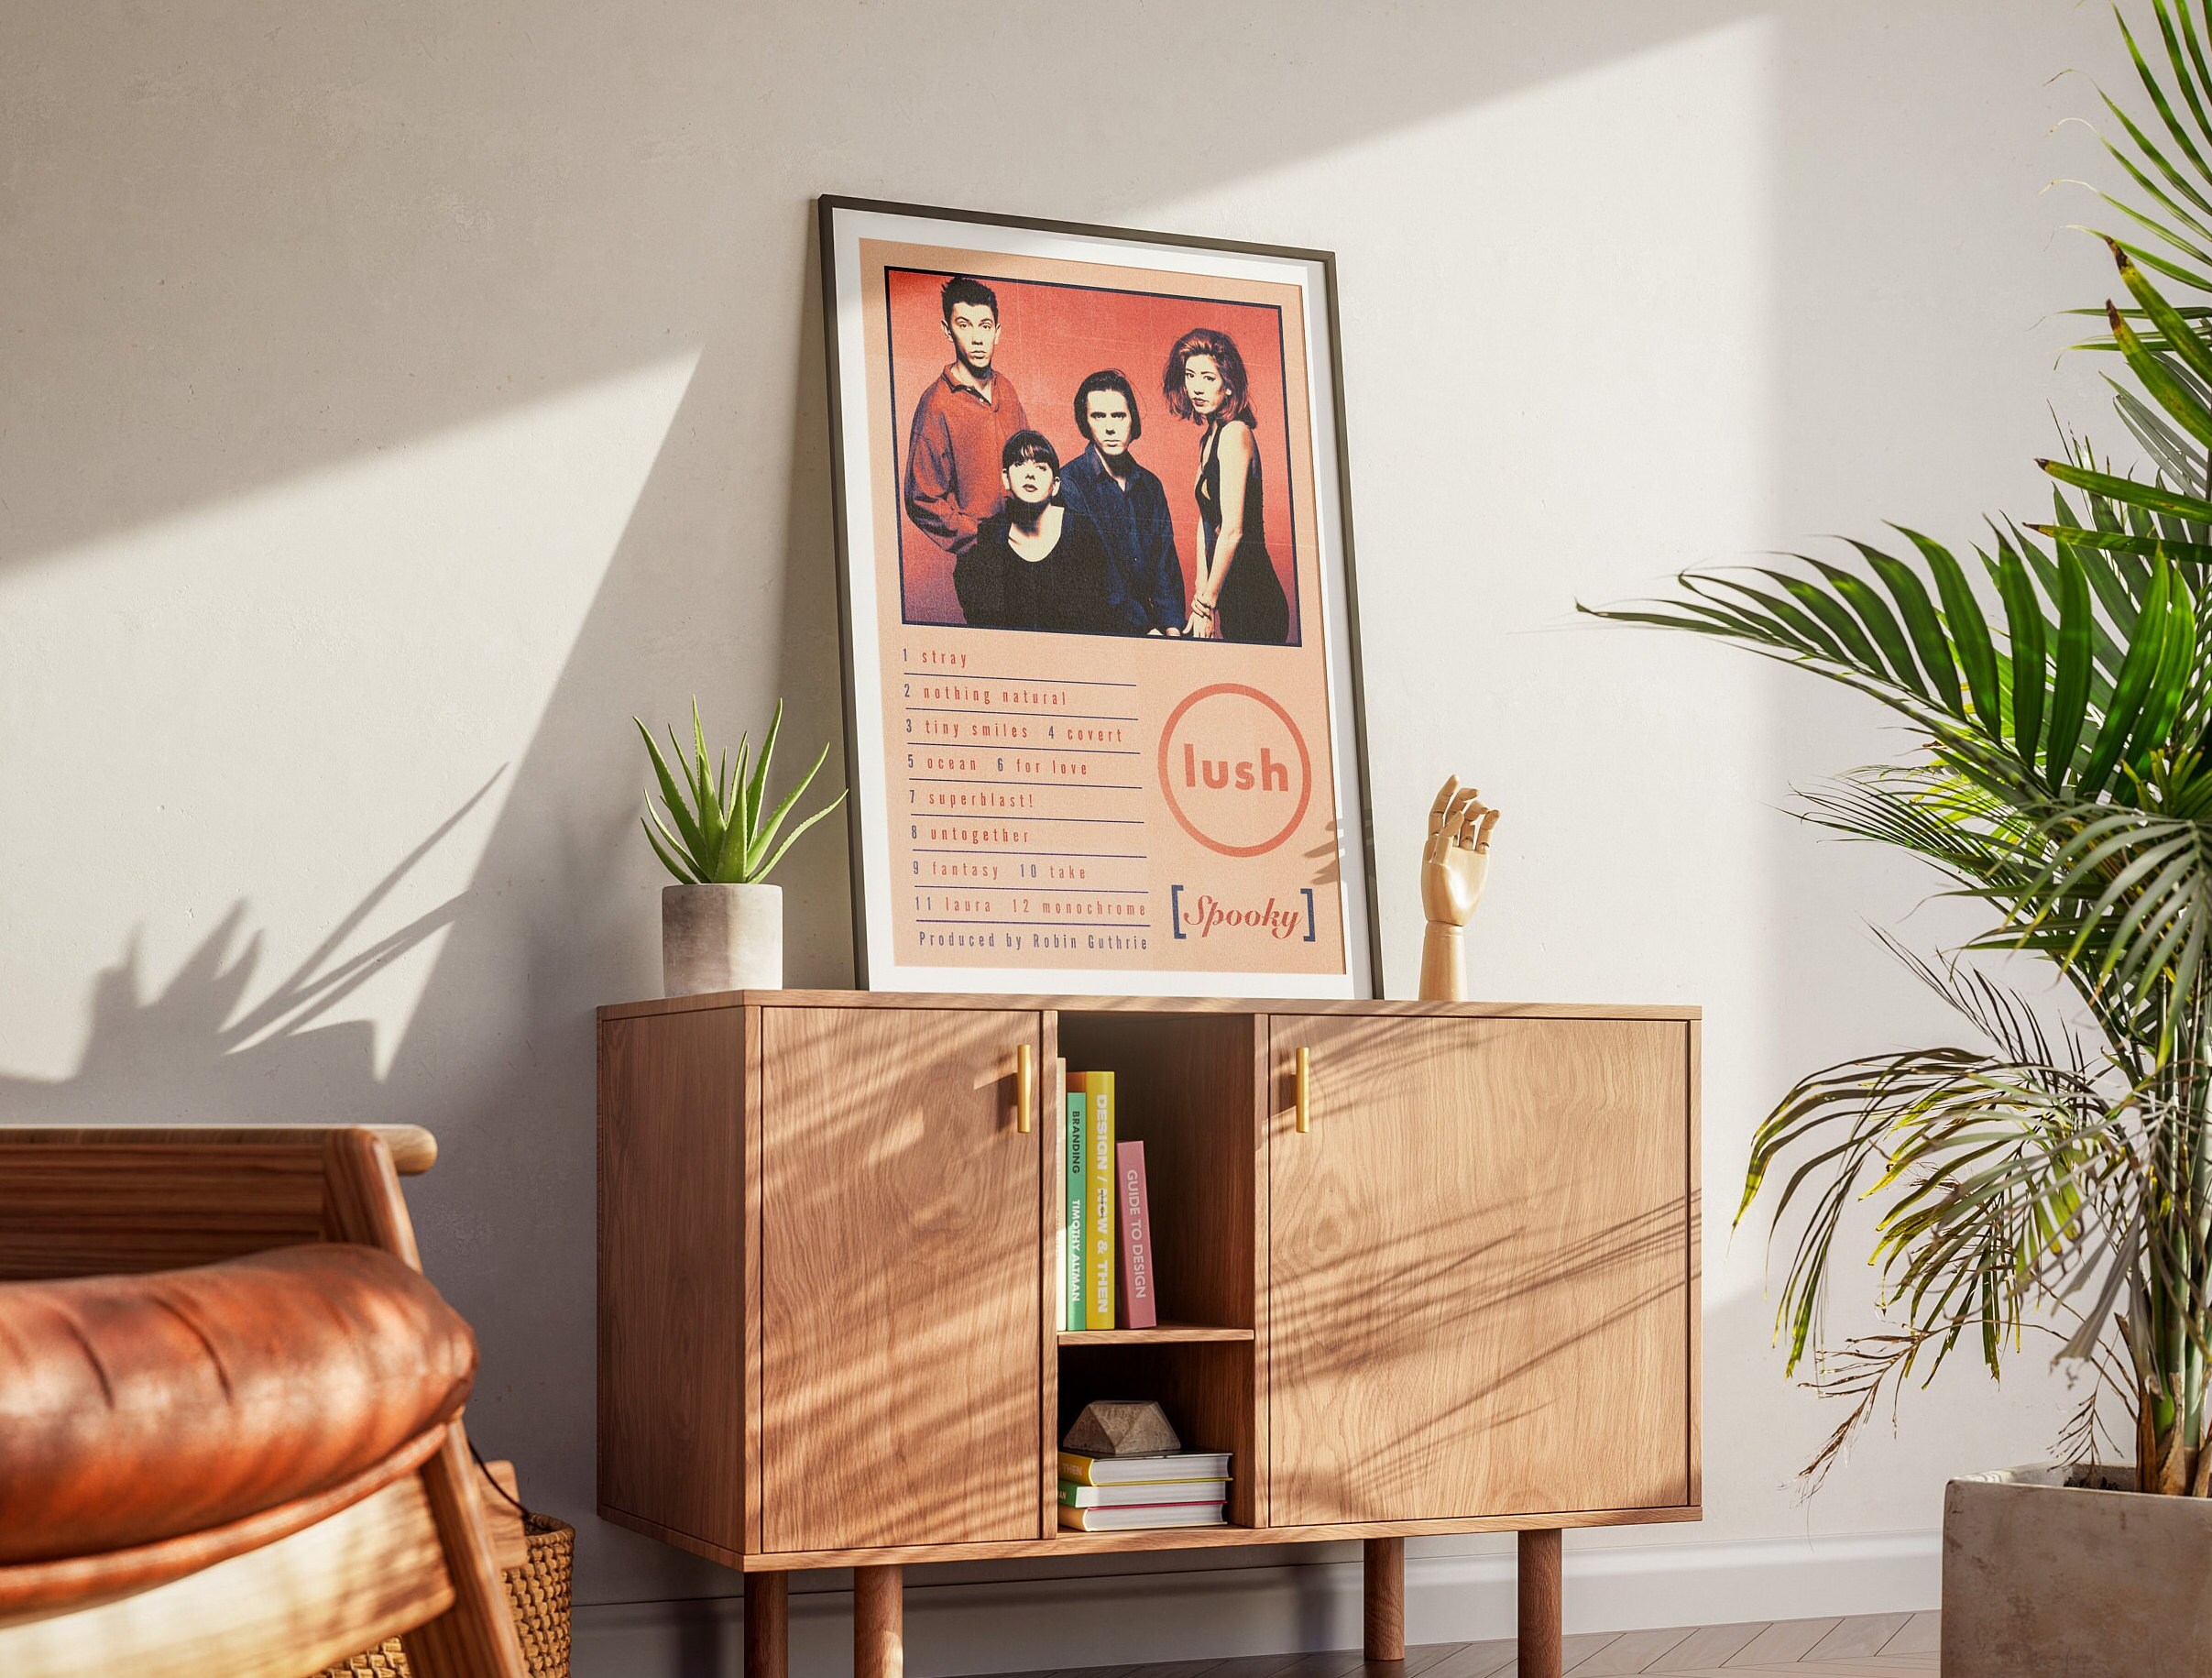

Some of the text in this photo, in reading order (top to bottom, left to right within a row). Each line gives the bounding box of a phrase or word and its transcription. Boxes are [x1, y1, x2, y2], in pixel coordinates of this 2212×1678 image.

[903, 649, 967, 668] 1 stray
[904, 684, 1066, 706] 2 nothing natural
[906, 719, 1122, 742] 3 tiny smiles 4 covert
[908, 754, 1087, 774] 5 ocean 6 for love
[1184, 743, 1289, 793] lush
[910, 790, 1034, 808] 7 superblast!
[912, 826, 1028, 844] 8 untogether
[914, 861, 1086, 880] 9 fantasy 10 take
[916, 896, 1145, 916] 11 laura 12 monochrome
[919, 931, 1146, 950] Produced by Robin Guthrie
[1072, 1111, 1080, 1174] BRANDING
[1097, 1094, 1108, 1170] DESIGN
[1097, 1190, 1108, 1234] NOW
[1127, 1169, 1146, 1299] GUIDE TO DESIGN
[1072, 1200, 1080, 1301] TIMOTHY ALTMAN
[1097, 1241, 1108, 1253] &
[1097, 1260, 1108, 1313] THEN
